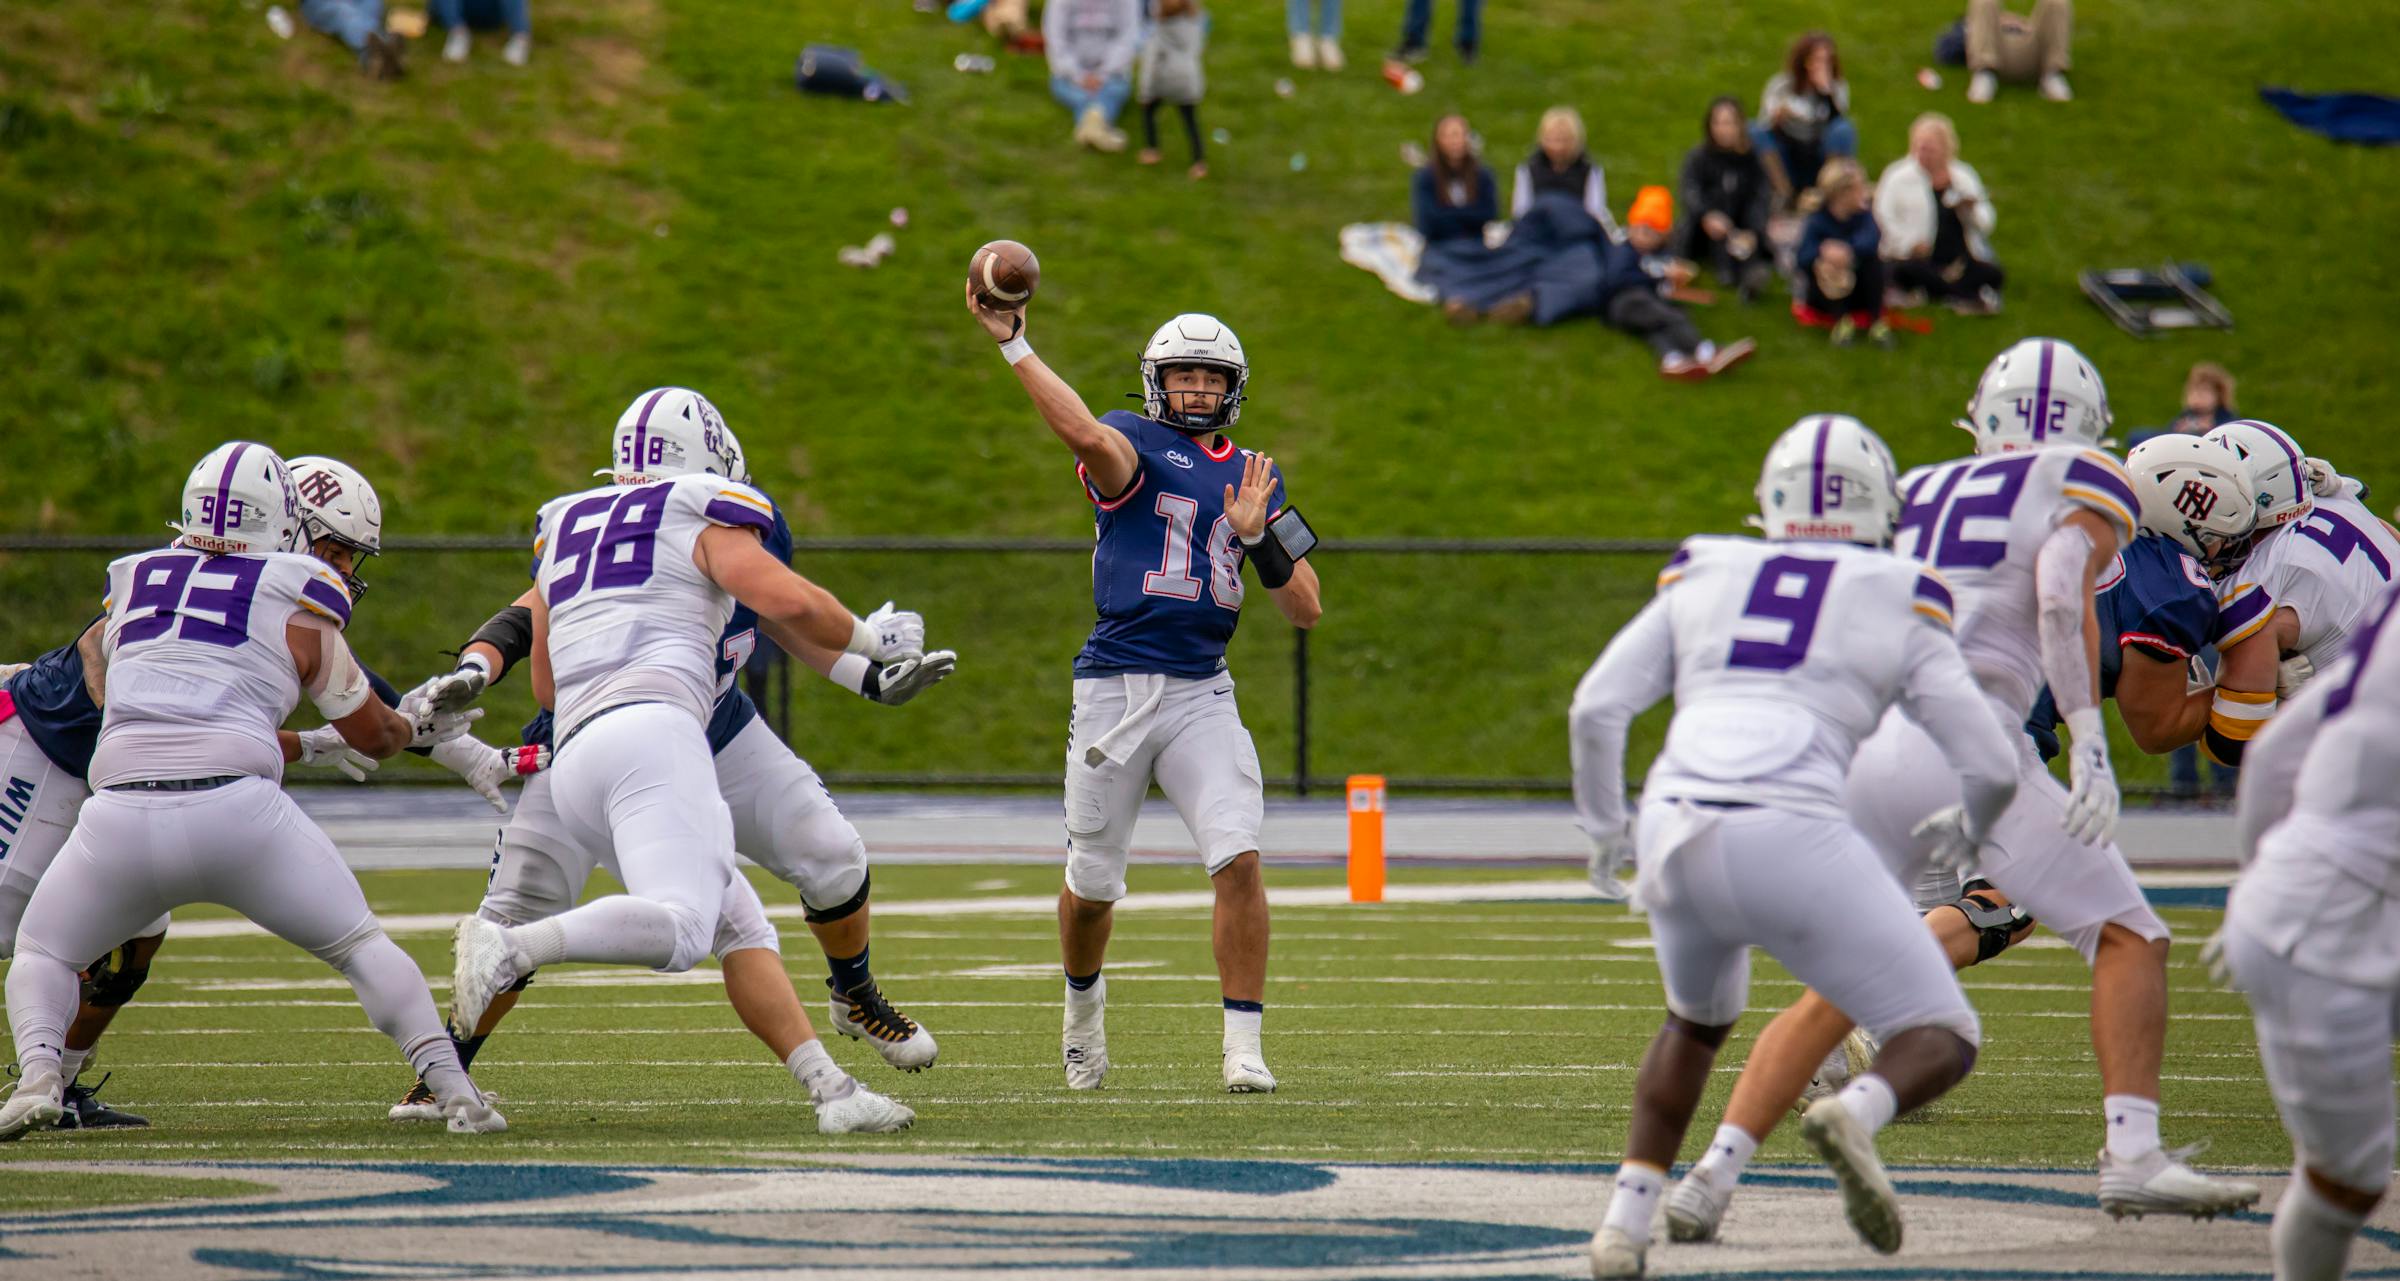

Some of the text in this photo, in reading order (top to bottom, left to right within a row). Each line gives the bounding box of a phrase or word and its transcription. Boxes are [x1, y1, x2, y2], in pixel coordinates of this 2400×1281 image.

[2016, 398, 2066, 432] 42
[621, 435, 664, 465] 58
[1166, 450, 1189, 466] CAA
[618, 475, 664, 486] Ridd
[1824, 475, 1843, 508] 9
[201, 495, 243, 528] 93
[1896, 454, 2039, 570] 42
[2276, 501, 2312, 524] Riddel
[549, 482, 675, 608] 58
[117, 555, 267, 648] 93
[1727, 554, 1838, 673] 9
